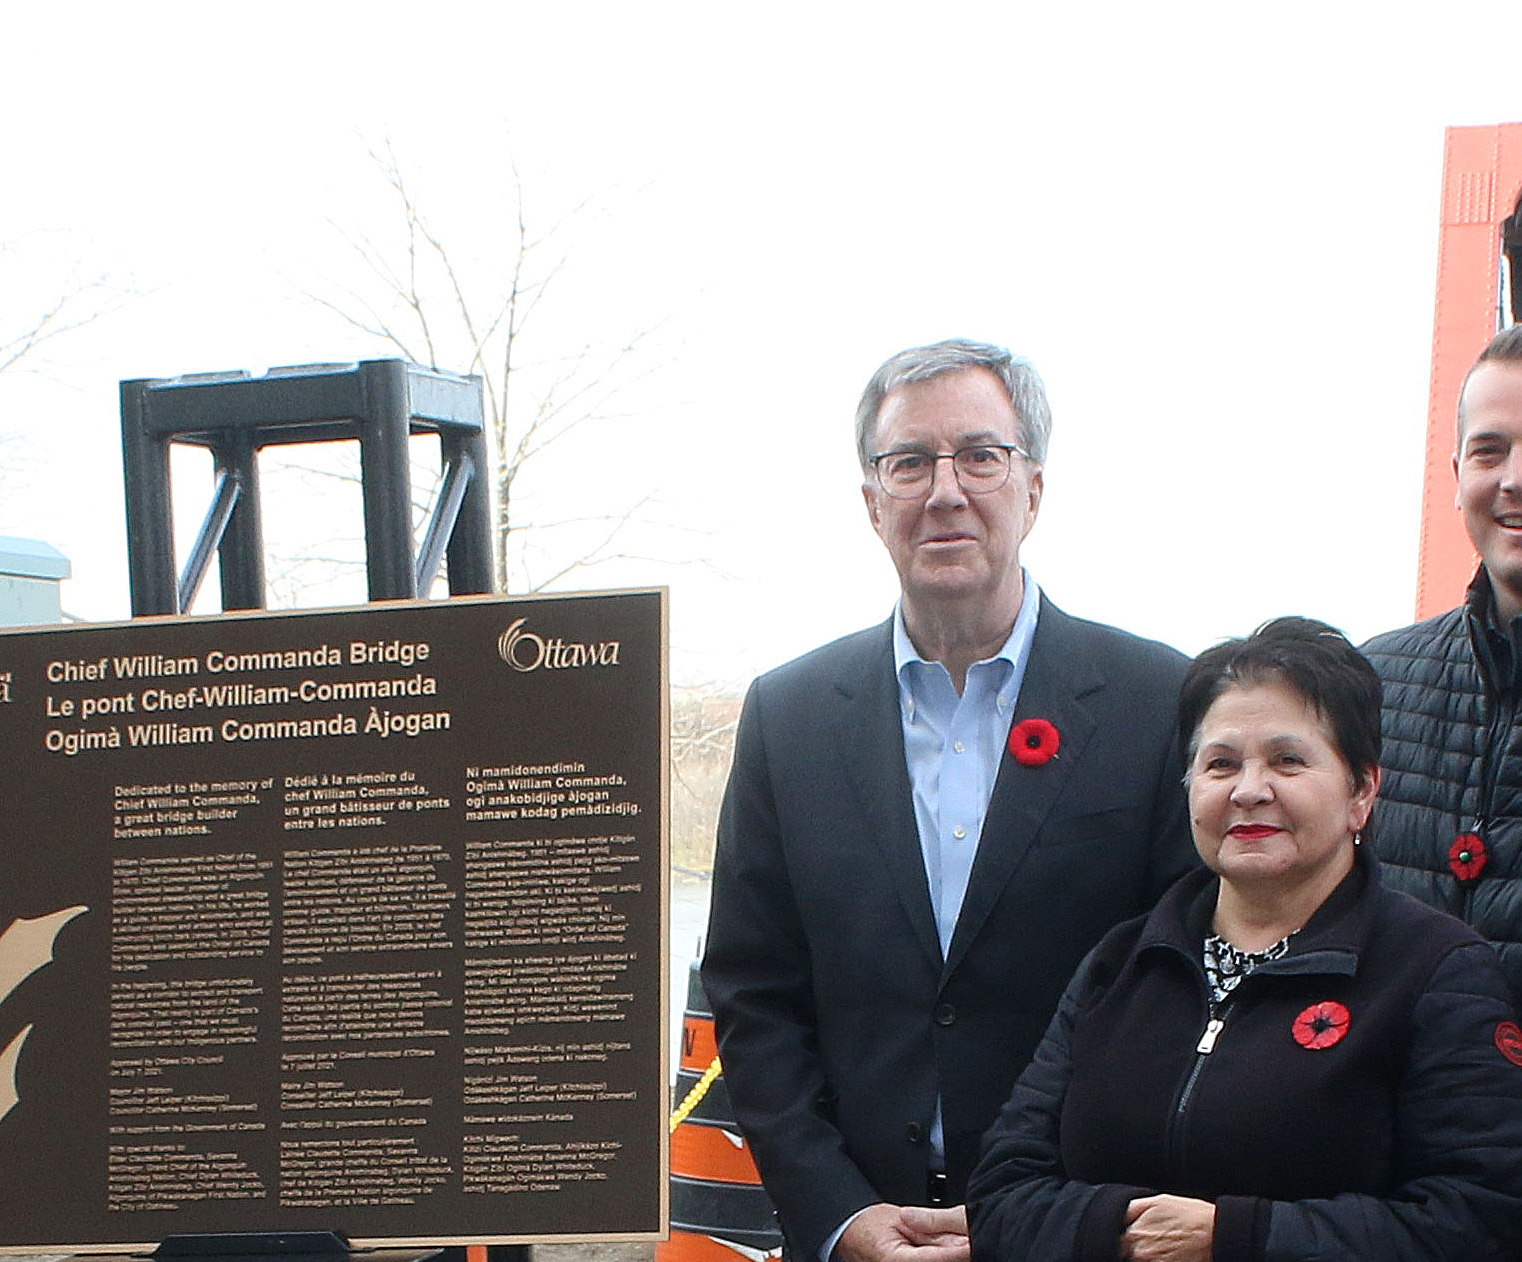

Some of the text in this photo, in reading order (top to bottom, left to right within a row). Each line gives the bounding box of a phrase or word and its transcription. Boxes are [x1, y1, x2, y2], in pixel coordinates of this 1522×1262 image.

[499, 619, 621, 672] Ottawa
[47, 642, 429, 682] Chief William Commanda Bridge
[47, 677, 436, 721] Le pont Chef-William-Commanda
[45, 706, 450, 756] Ogimà William Commanda Àjogan
[331, 774, 342, 785] la
[345, 771, 397, 785] mémoire
[399, 770, 415, 782] du
[482, 763, 585, 777] mamidonendimin
[115, 778, 273, 797] Dedicated to the memory of
[507, 778, 551, 791] William
[114, 798, 145, 810] Chief
[147, 796, 189, 809] William
[284, 790, 311, 802] chef
[312, 788, 356, 800] William
[284, 807, 299, 816] un
[302, 803, 337, 818] grand
[397, 799, 413, 811] de
[415, 798, 450, 813] ponts
[465, 810, 517, 820] mamawe
[521, 806, 557, 821] kodag
[114, 808, 237, 828] a great bridge builder
[283, 814, 386, 830] entre les nations.
[113, 824, 211, 838] between nations.
